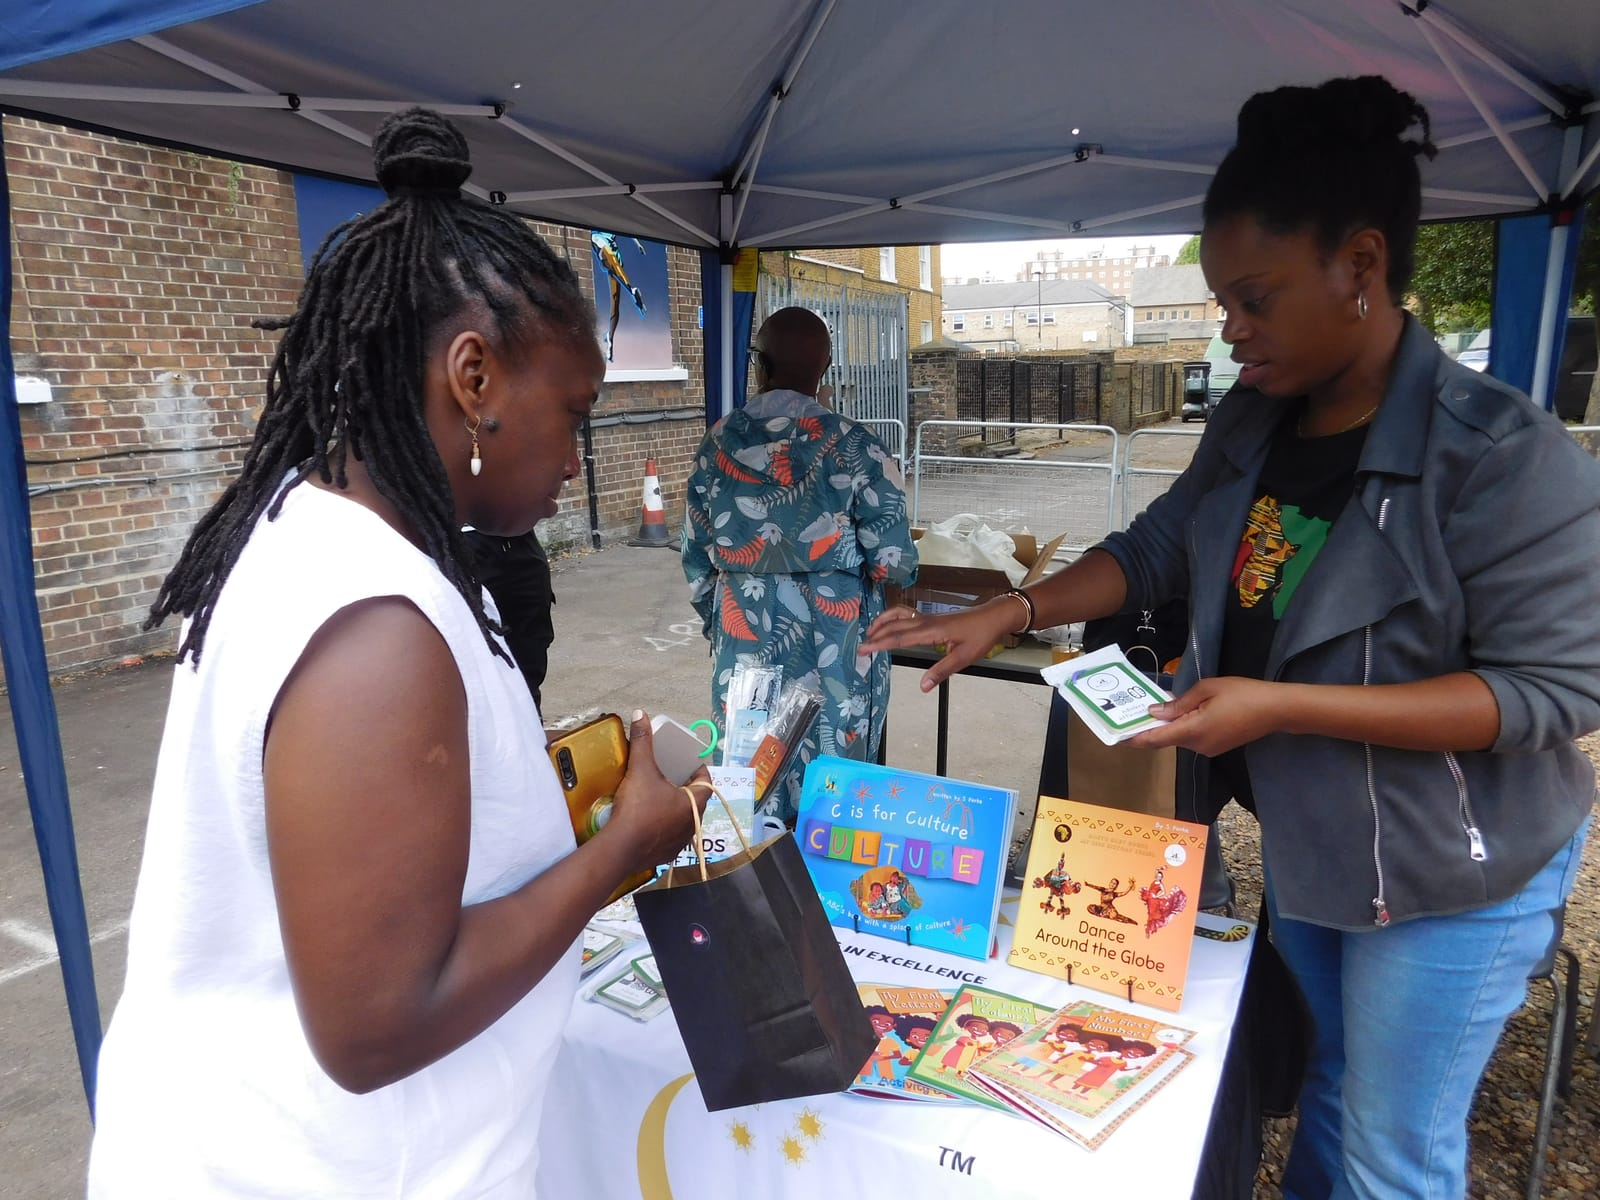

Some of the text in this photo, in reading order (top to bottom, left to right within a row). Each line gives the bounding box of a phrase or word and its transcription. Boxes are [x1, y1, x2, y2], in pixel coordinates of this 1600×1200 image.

[831, 804, 968, 840] C is for Culture
[810, 828, 974, 876] CULTURE
[864, 919, 879, 927] with
[915, 923, 922, 931] of
[925, 920, 951, 930] culture
[1078, 920, 1125, 944] Dance
[843, 945, 988, 985] IN EXCELLENCE
[1035, 927, 1165, 973] Around the Globe
[881, 991, 899, 1002] My
[1087, 1022, 1146, 1038] Numbers
[938, 1145, 976, 1176] TM
